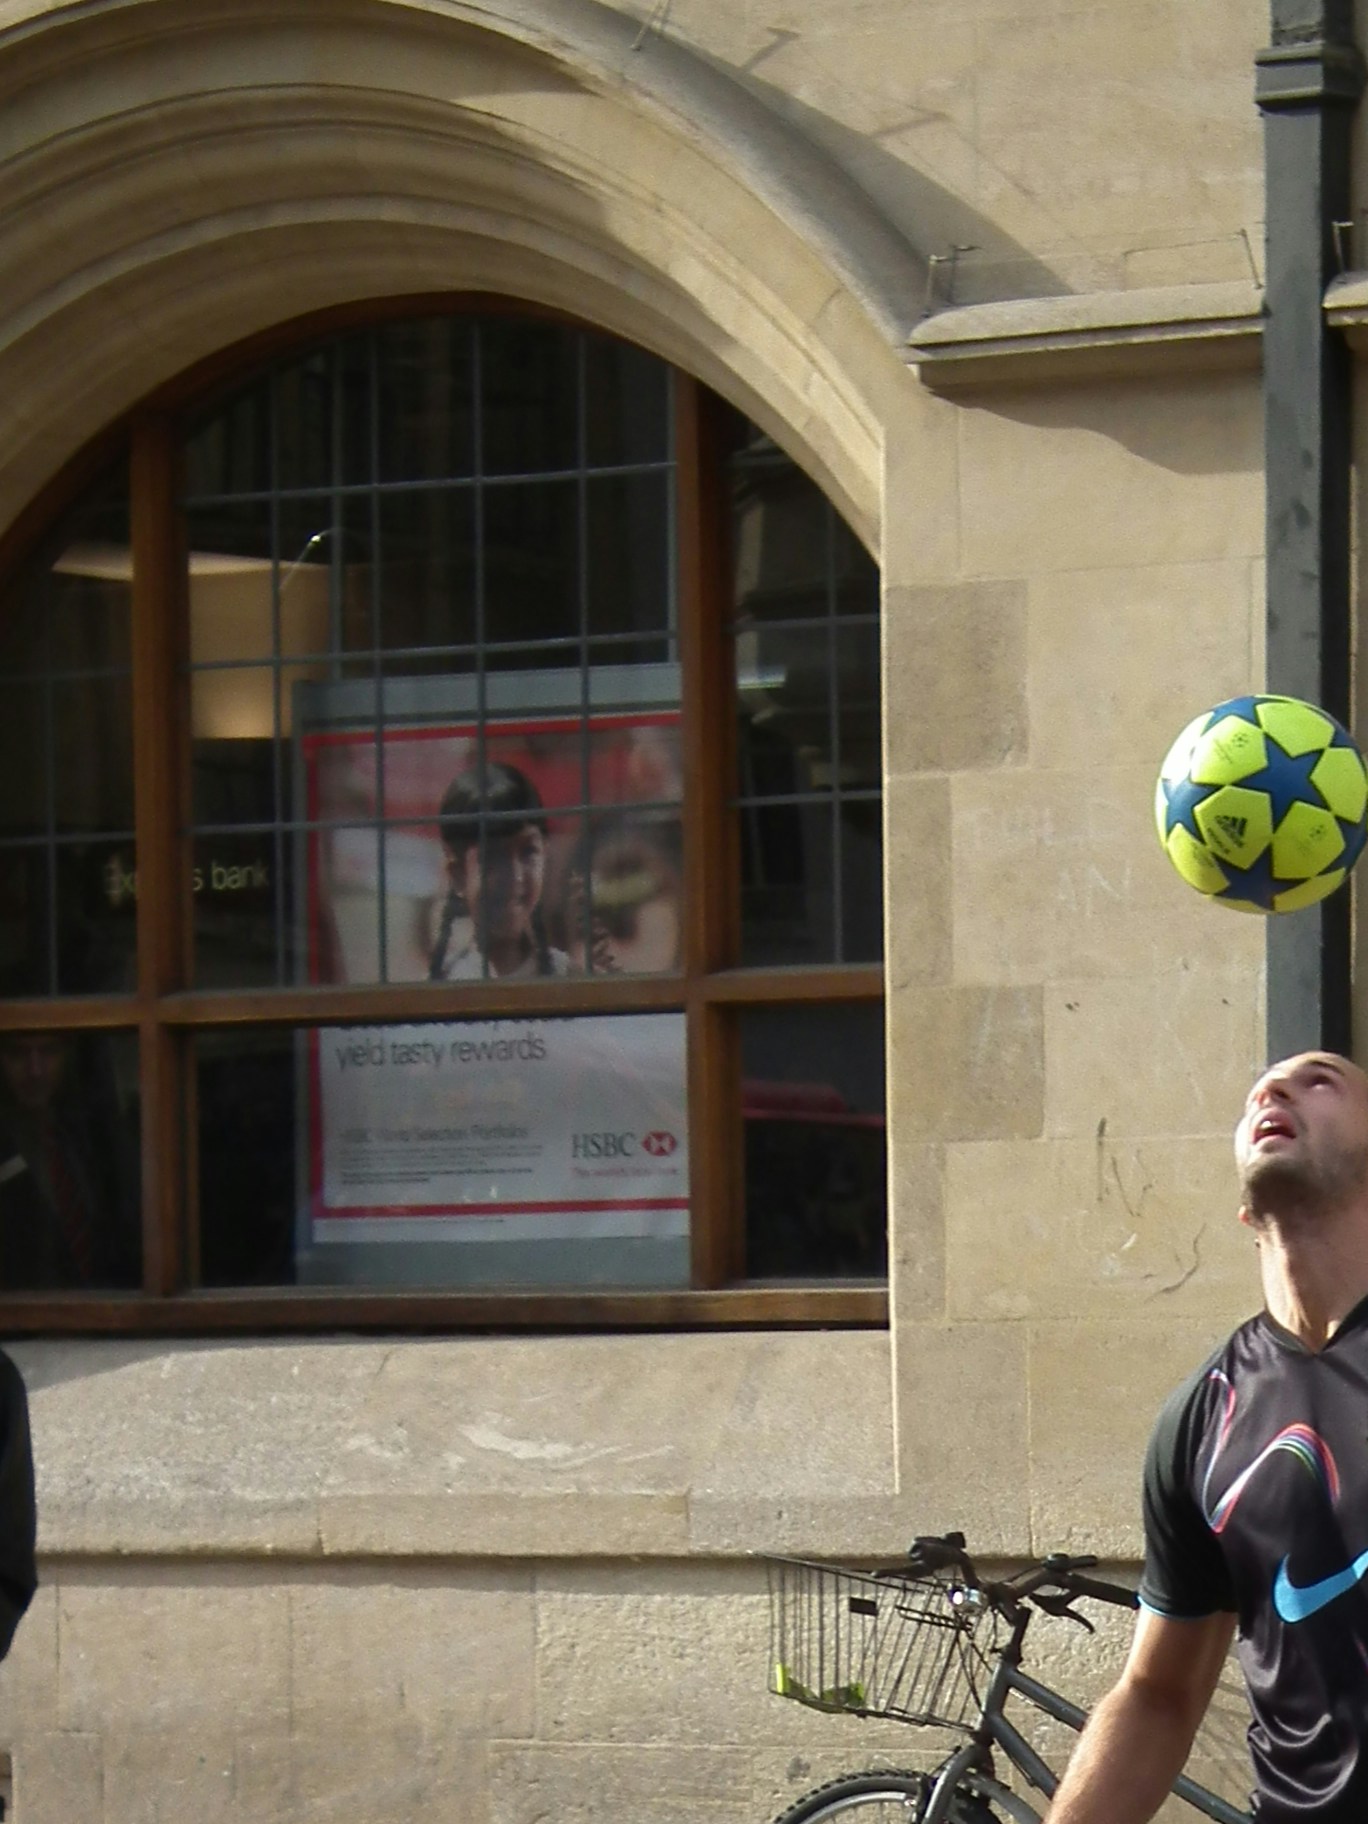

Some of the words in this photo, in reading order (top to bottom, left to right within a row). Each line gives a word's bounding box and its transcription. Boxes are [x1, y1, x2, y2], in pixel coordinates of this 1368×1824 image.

[211, 858, 269, 890] bank
[335, 1036, 385, 1071] yield
[391, 1037, 444, 1067] tasty
[450, 1031, 547, 1062] rewards
[571, 1131, 636, 1159] HSBC
